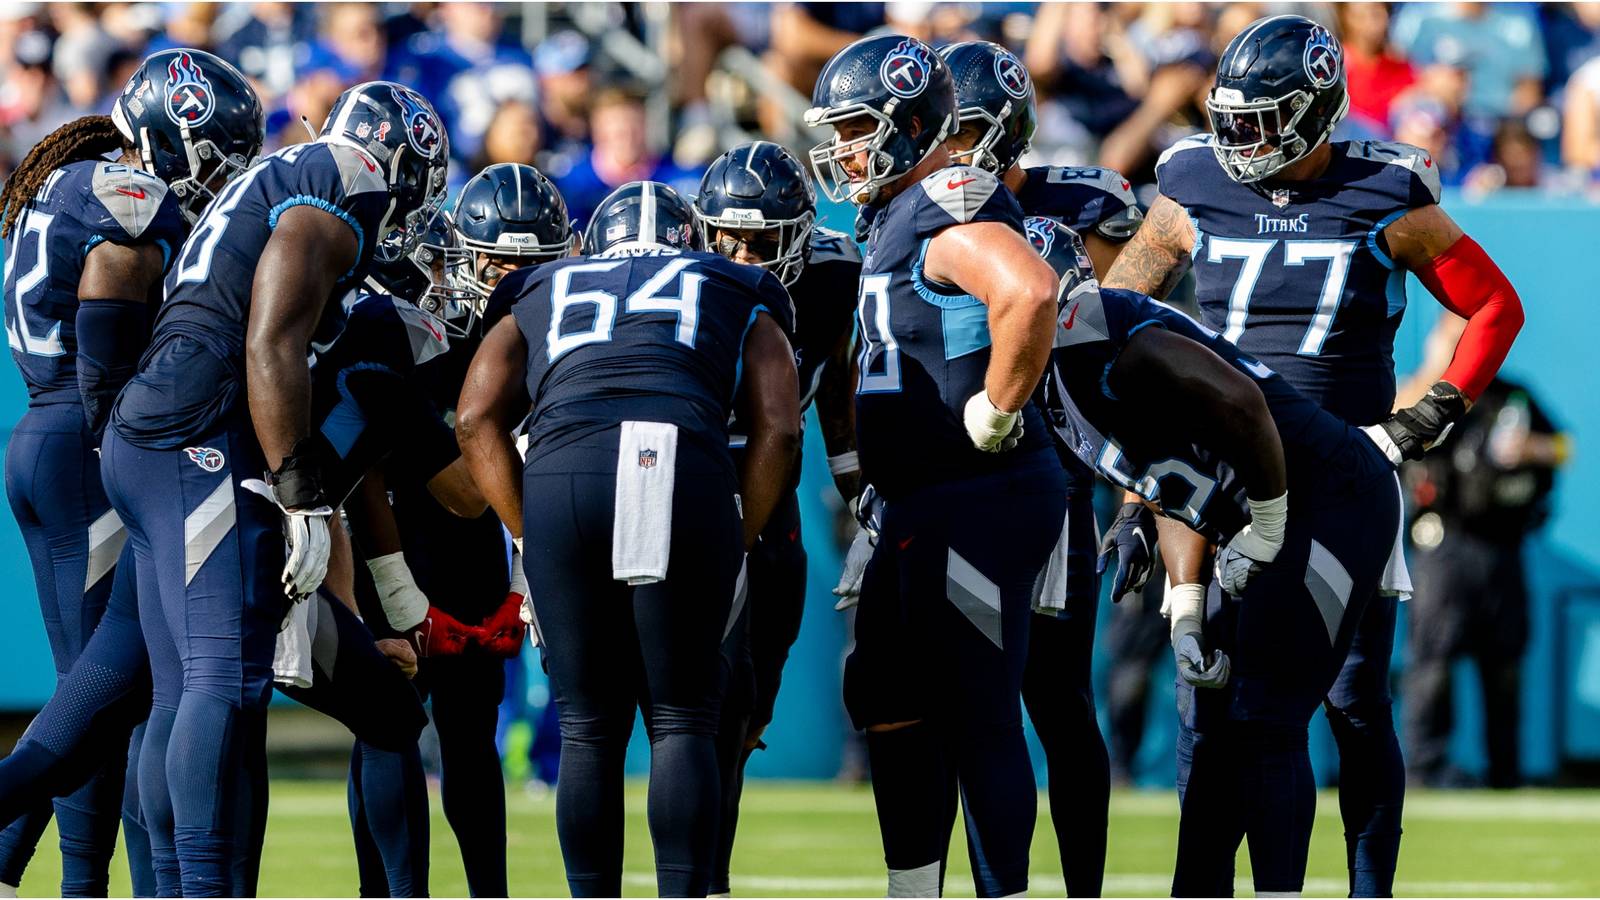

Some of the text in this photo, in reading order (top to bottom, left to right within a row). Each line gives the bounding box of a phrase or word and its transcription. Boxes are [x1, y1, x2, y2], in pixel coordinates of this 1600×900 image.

[507, 235, 529, 244] TITANS
[1255, 213, 1309, 235] TITANS
[546, 257, 709, 364] 64
[856, 271, 903, 394] 0
[1207, 235, 1361, 357] 77
